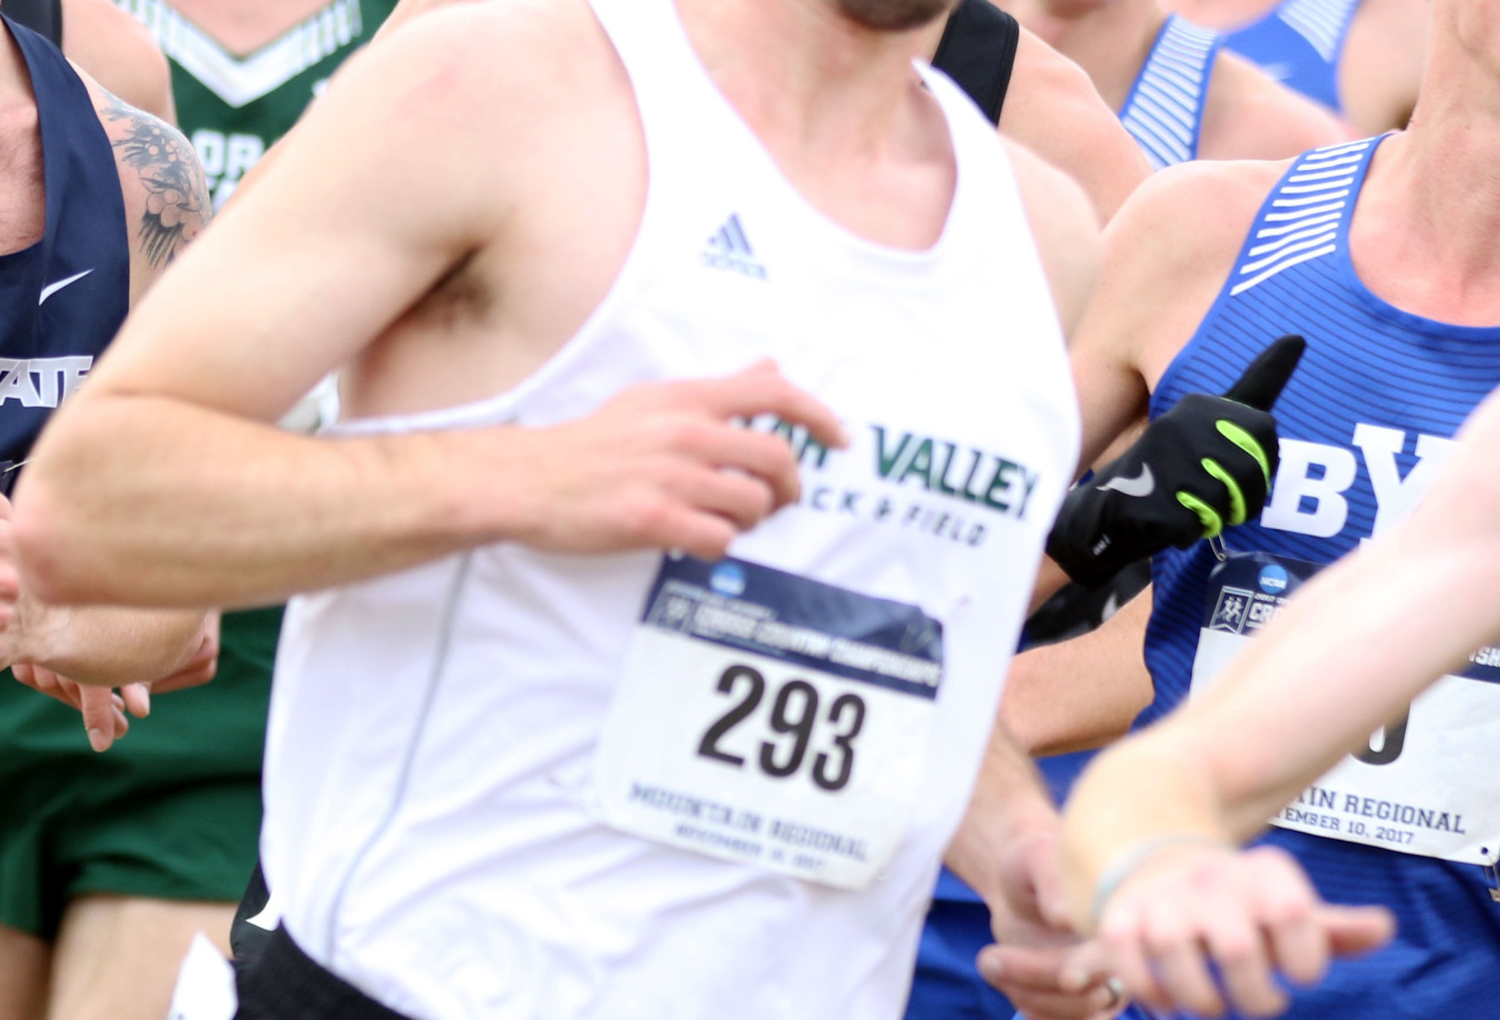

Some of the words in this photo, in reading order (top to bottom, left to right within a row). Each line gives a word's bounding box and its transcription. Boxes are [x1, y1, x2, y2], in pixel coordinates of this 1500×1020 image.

[869, 423, 1040, 519] VALLEY
[1261, 423, 1457, 547] BY
[696, 662, 867, 793] 293
[1276, 806, 1340, 831] EMBER
[1348, 821, 1370, 837] 10,
[1376, 827, 1415, 845] 2017
[1343, 793, 1466, 835] REGIONAL
